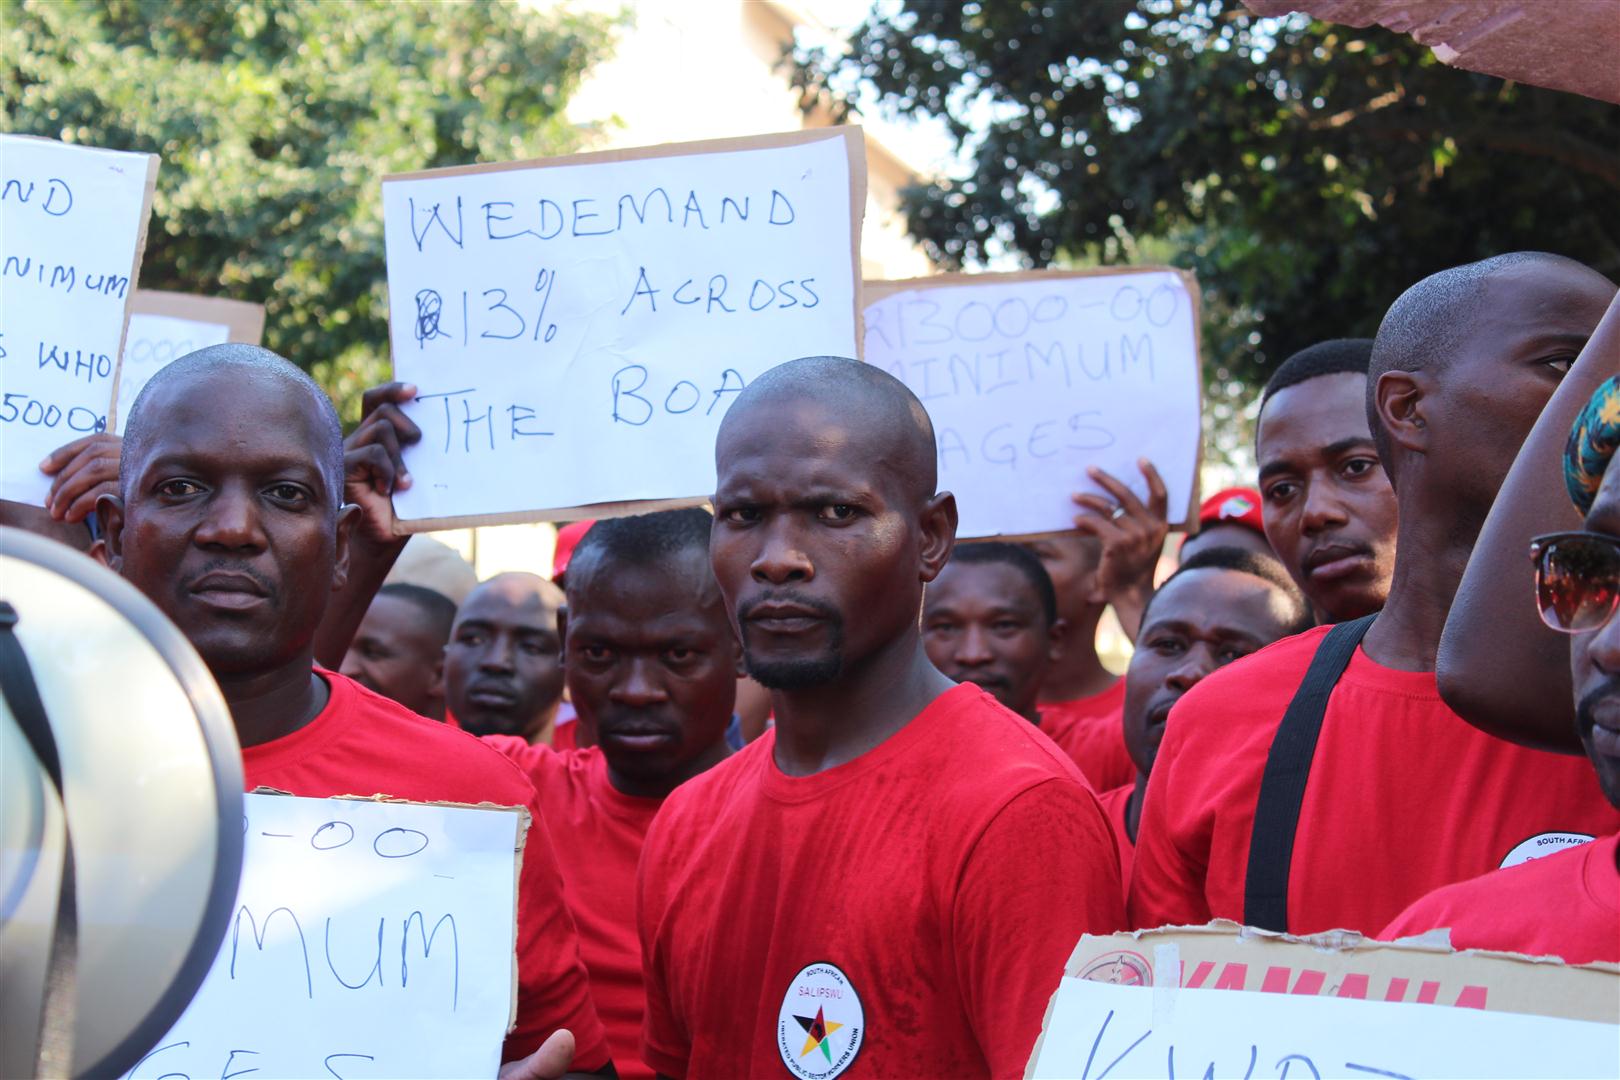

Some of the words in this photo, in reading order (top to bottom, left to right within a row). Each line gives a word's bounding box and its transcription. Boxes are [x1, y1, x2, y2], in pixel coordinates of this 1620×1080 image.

[622, 266, 821, 315] ACROSS
[38, 341, 112, 382] WHO
[415, 388, 554, 453] THE
[1537, 837, 1565, 847] SOUTH
[847, 1027, 859, 1051] UNION
